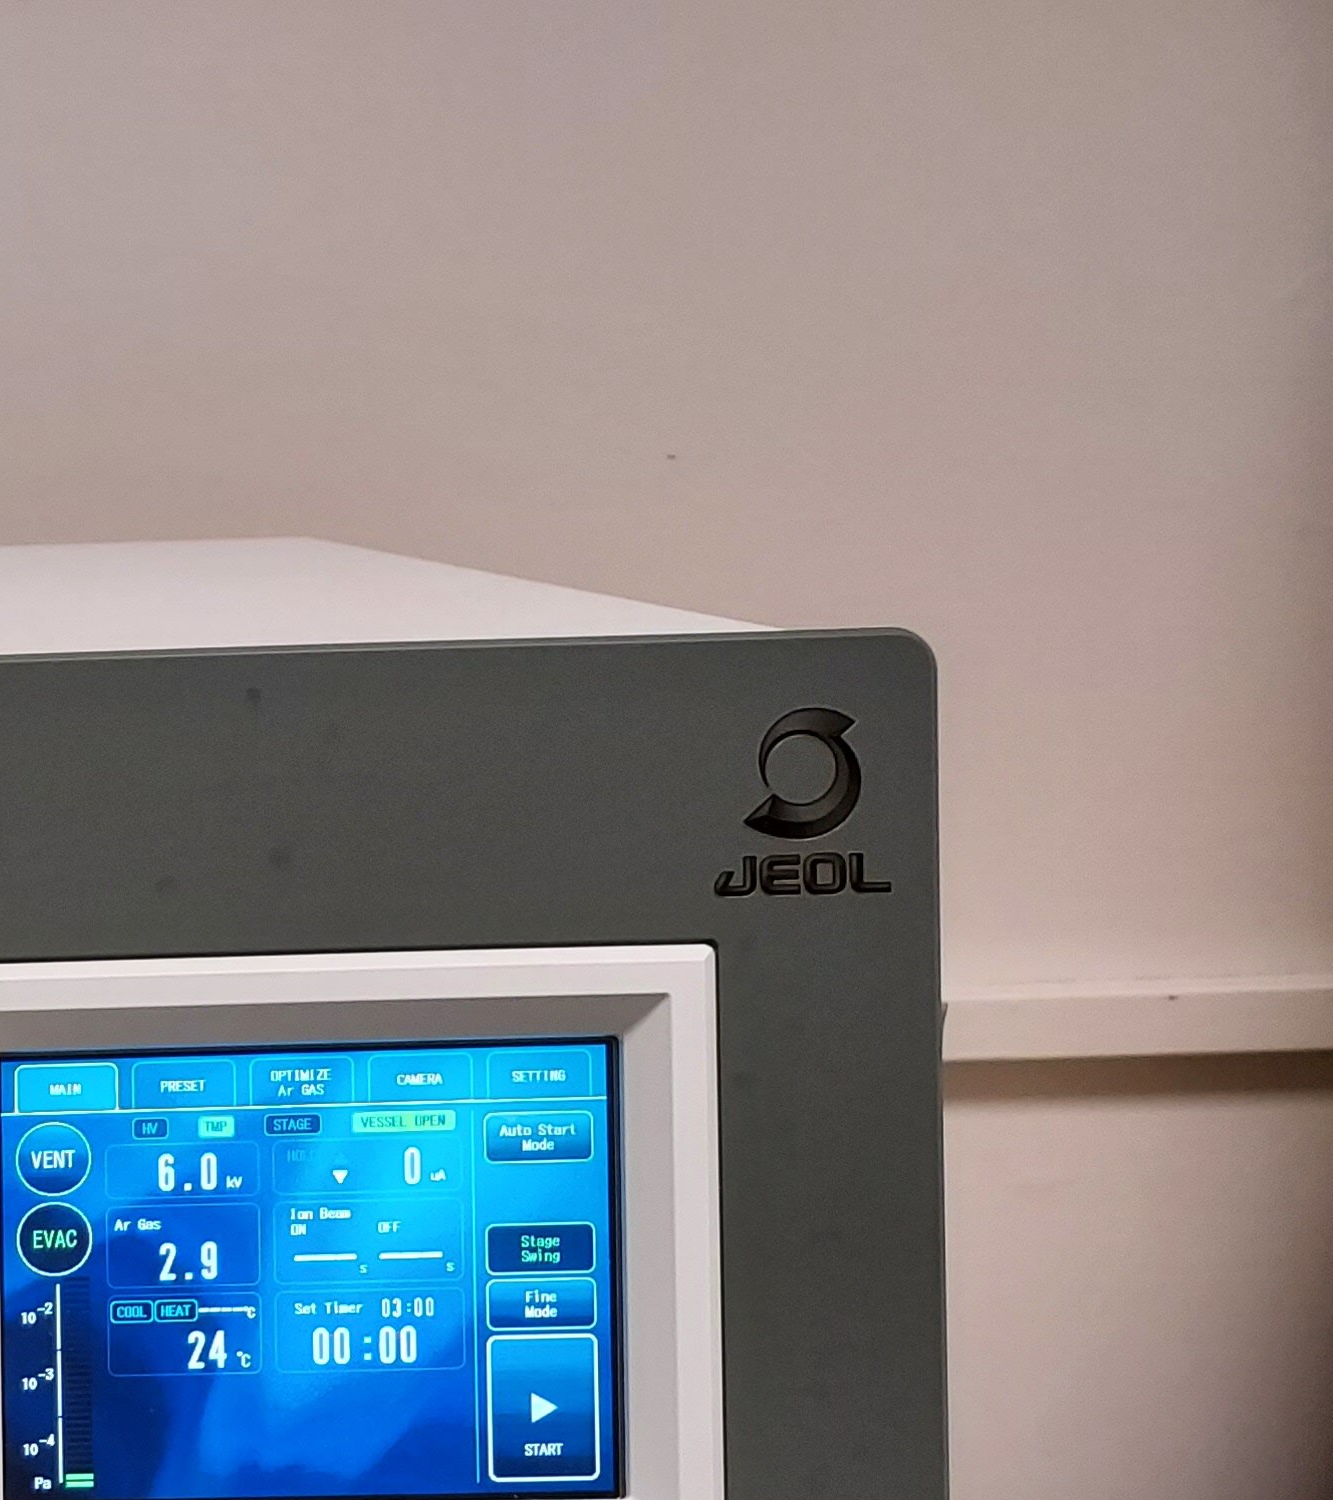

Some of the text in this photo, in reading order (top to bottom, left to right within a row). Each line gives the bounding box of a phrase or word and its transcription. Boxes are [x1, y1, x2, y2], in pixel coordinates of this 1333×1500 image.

[714, 852, 892, 896] JEOL
[270, 1069, 332, 1083] OPTIMIZE
[396, 1073, 443, 1086] CAMERA
[511, 1070, 566, 1083] SETTING
[50, 1084, 82, 1096] MAIN
[160, 1079, 205, 1093] PRESET
[278, 1084, 324, 1097] Ar GAS
[273, 1118, 312, 1131] STAGE
[360, 1114, 446, 1128] VESSEL OPEN
[142, 1123, 158, 1135] HV
[499, 1122, 576, 1137] Auto Start
[522, 1139, 555, 1152] Mode
[31, 1149, 76, 1169] VENT
[404, 1147, 421, 1185] 0
[157, 1152, 218, 1192] 6.0
[290, 1206, 351, 1220] Ion Beam
[114, 1218, 162, 1232] Ar Gas
[290, 1222, 307, 1236] ON
[378, 1220, 401, 1234] OFF
[33, 1229, 78, 1249] EVAC
[521, 1235, 560, 1249] Stage
[159, 1241, 218, 1281] 2.9
[521, 1250, 560, 1265] Swing
[525, 1290, 558, 1304] Fine
[117, 1306, 147, 1318] COOL
[160, 1304, 191, 1317] HEAT
[294, 1297, 435, 1318] Set Timer 03:00
[524, 1305, 558, 1319] Mode
[187, 1330, 227, 1370] 24
[312, 1325, 417, 1365] 00:00
[524, 1443, 564, 1457] START
[34, 1477, 52, 1490] Pa
